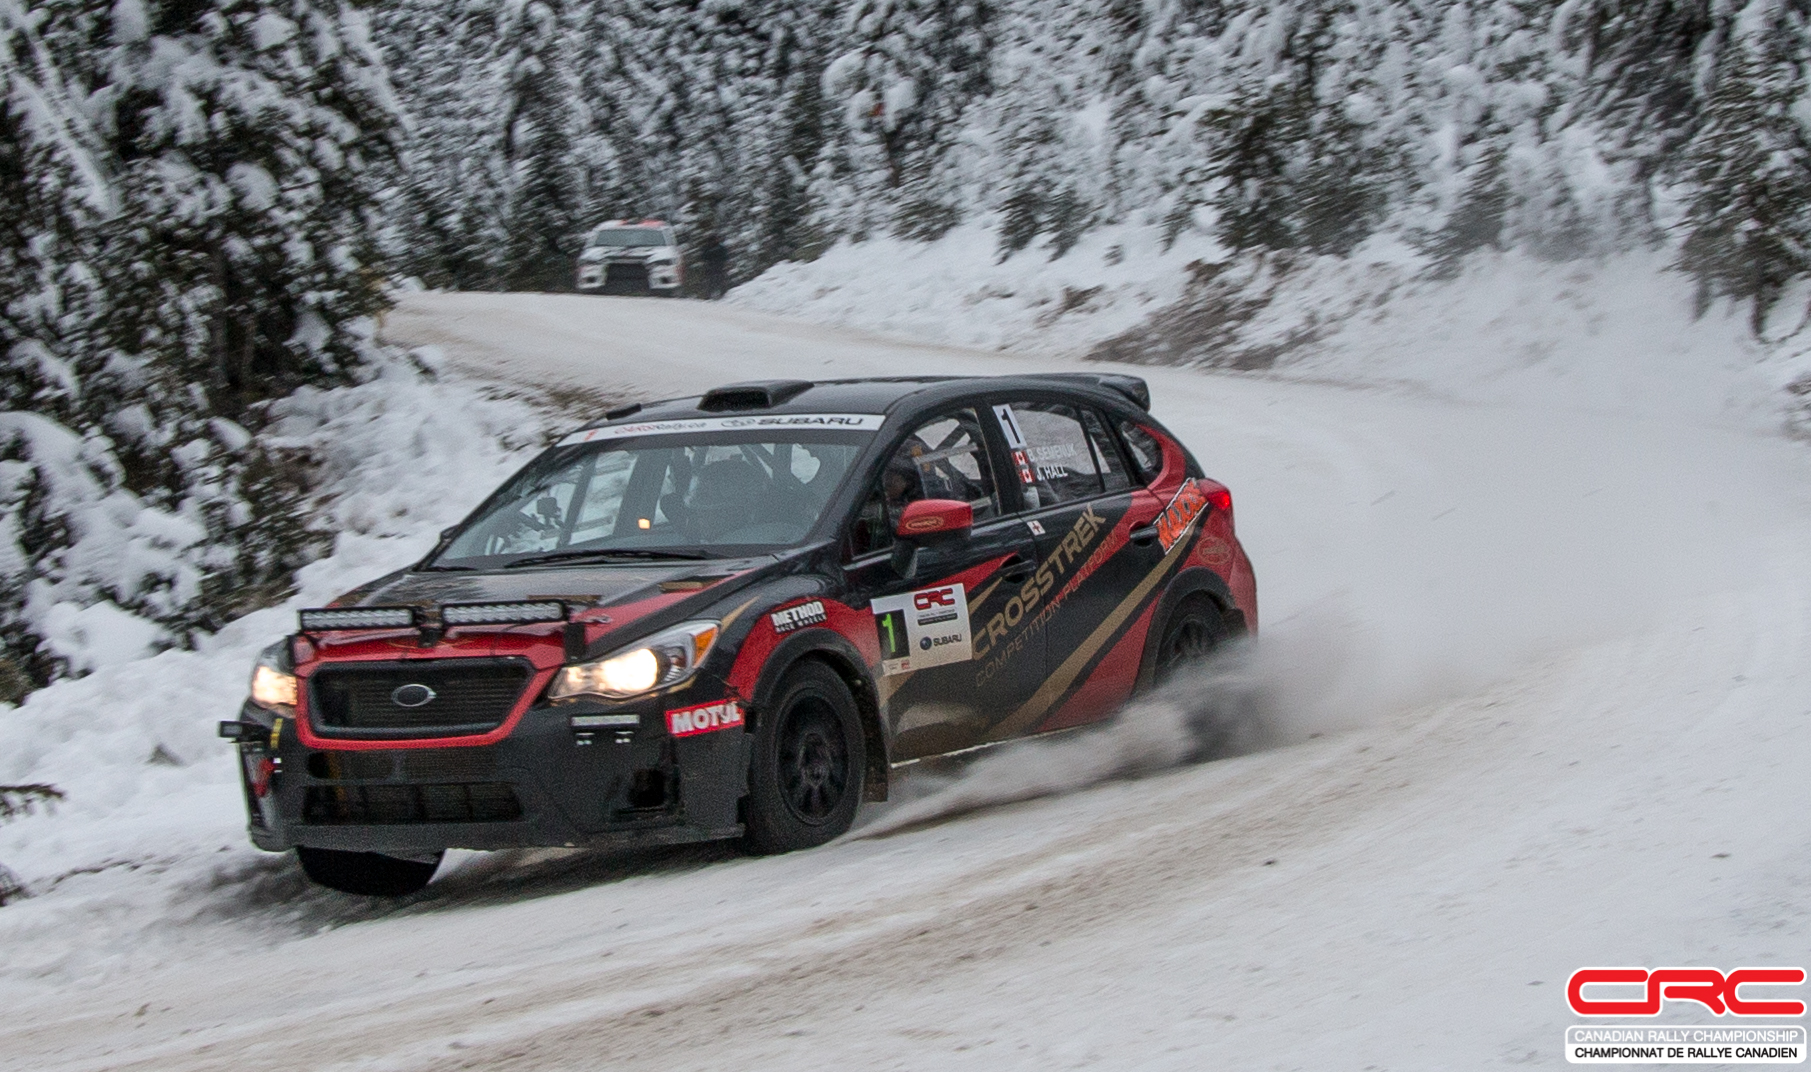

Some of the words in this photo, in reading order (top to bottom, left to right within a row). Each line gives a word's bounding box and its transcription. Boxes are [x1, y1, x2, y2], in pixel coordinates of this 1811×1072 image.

[757, 417, 864, 426] SUBARU
[1000, 408, 1021, 444] 1
[970, 502, 1107, 661] CROSSTREK
[770, 600, 825, 627] METHOD
[913, 587, 957, 611] CRC
[881, 613, 897, 653] 1
[932, 633, 963, 648] SUBARU
[670, 701, 742, 734] MOTUL
